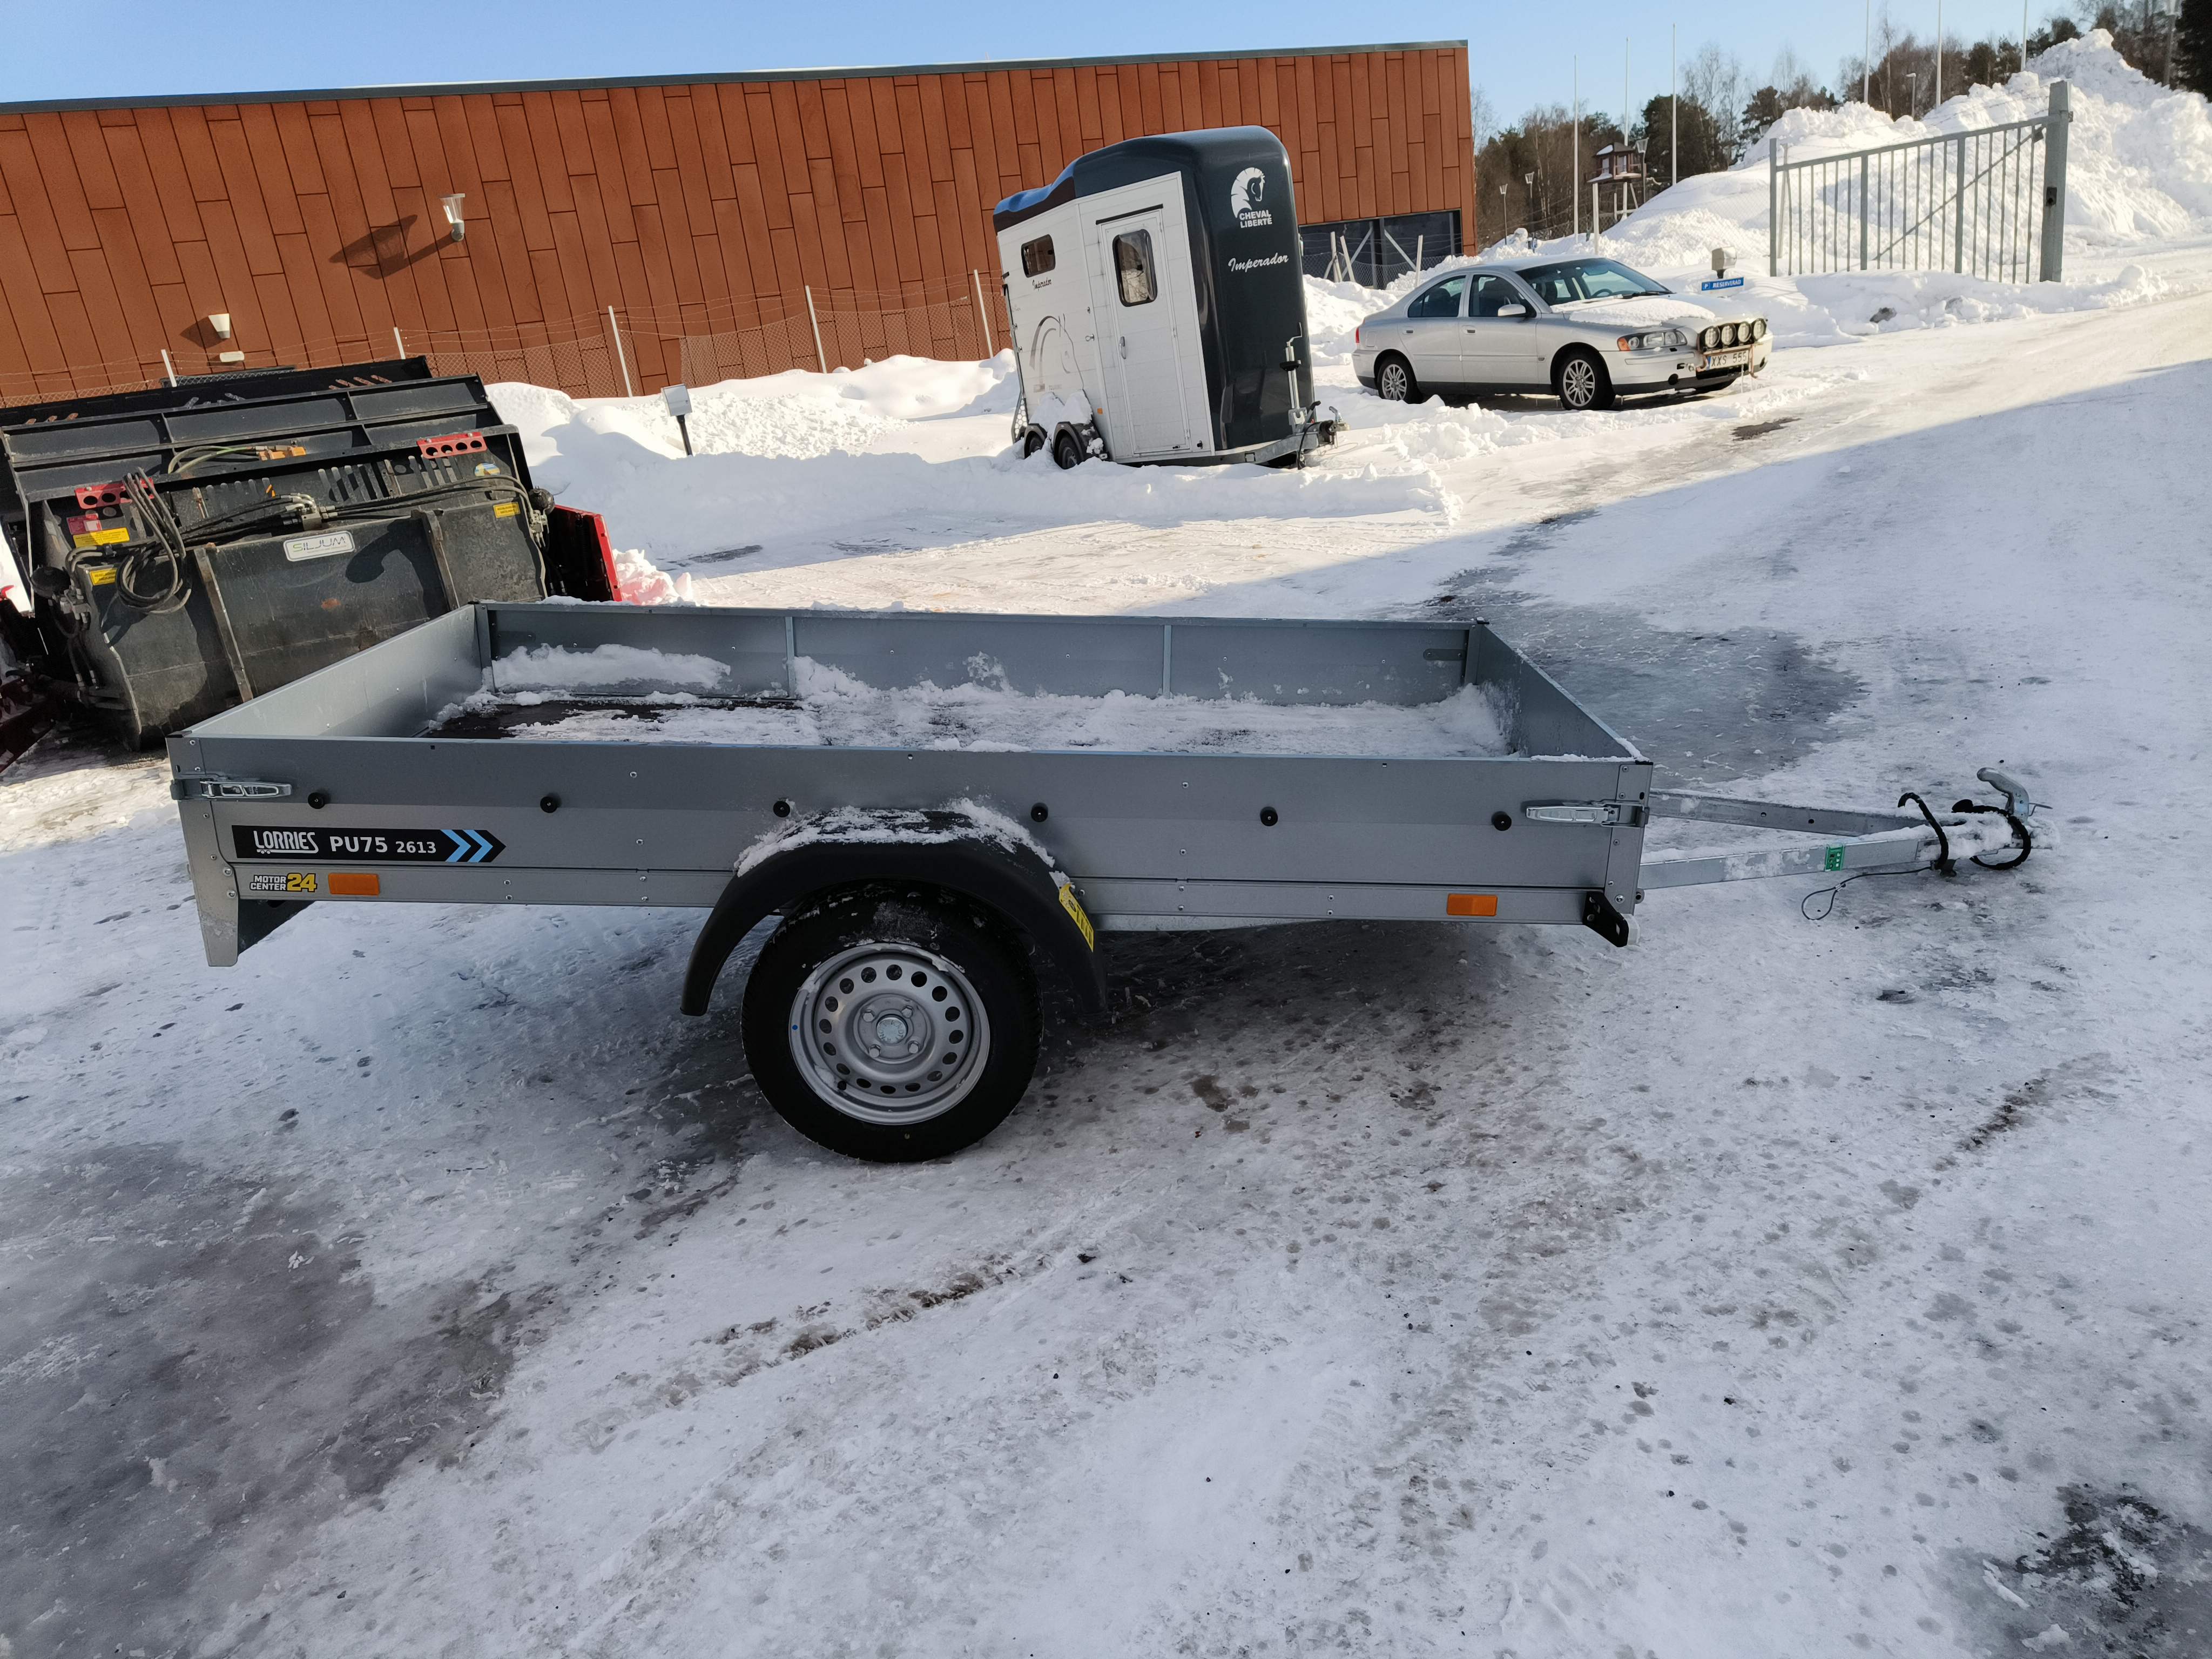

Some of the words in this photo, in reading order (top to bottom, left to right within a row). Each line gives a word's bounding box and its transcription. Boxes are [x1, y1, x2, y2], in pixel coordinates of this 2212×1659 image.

[1239, 210, 1272, 220] CHEVAL
[1228, 252, 1289, 273] Imperador
[1712, 279, 1742, 288] RESERVERAD
[1711, 355, 1728, 367] XXS
[1732, 351, 1747, 363] 555
[293, 536, 346, 552] SILJUM
[253, 831, 319, 854] LORRIES
[329, 836, 388, 853] PU75
[395, 841, 436, 854] 2613
[250, 882, 286, 891] CENTER
[254, 875, 286, 884] MOTOR
[287, 873, 317, 892] 24
